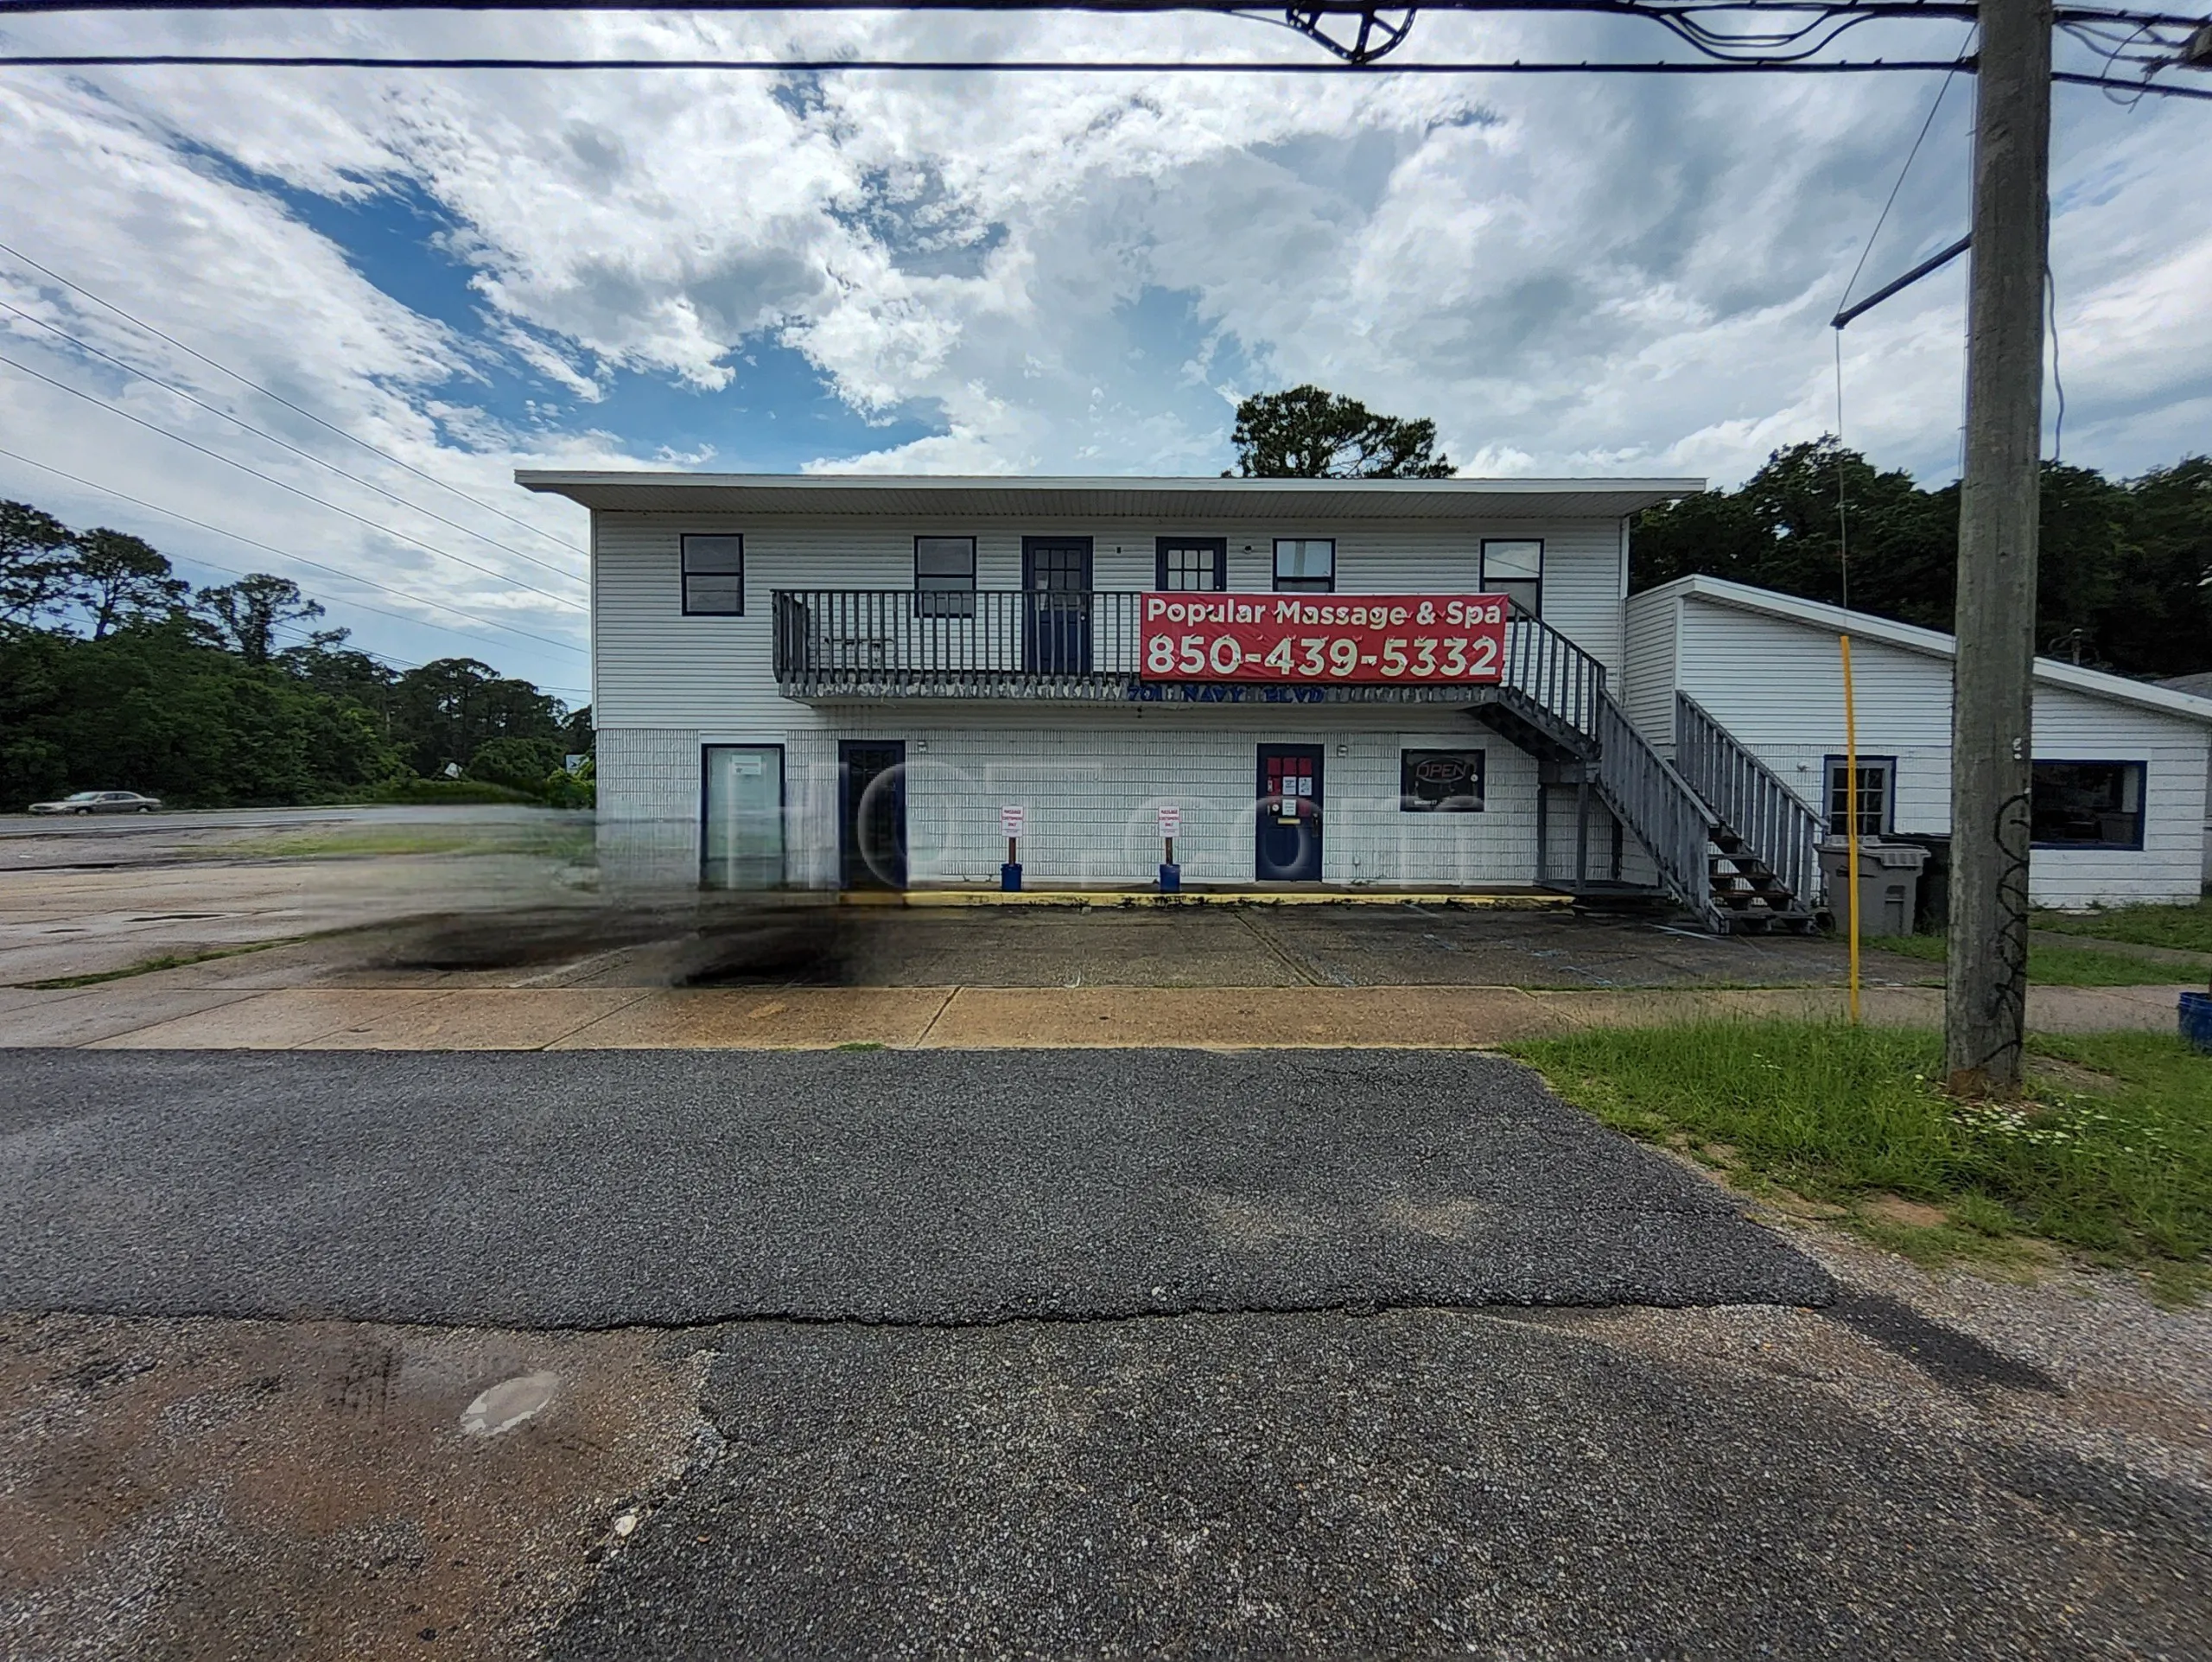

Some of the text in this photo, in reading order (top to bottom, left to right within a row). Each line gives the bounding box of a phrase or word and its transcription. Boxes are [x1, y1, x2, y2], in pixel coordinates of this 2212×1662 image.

[1147, 598, 1501, 630] Popular Massage & Spa
[1147, 634, 1497, 678] 850-439-5332
[1182, 685, 1245, 702] NAVY
[1416, 764, 1467, 778] OPEN
